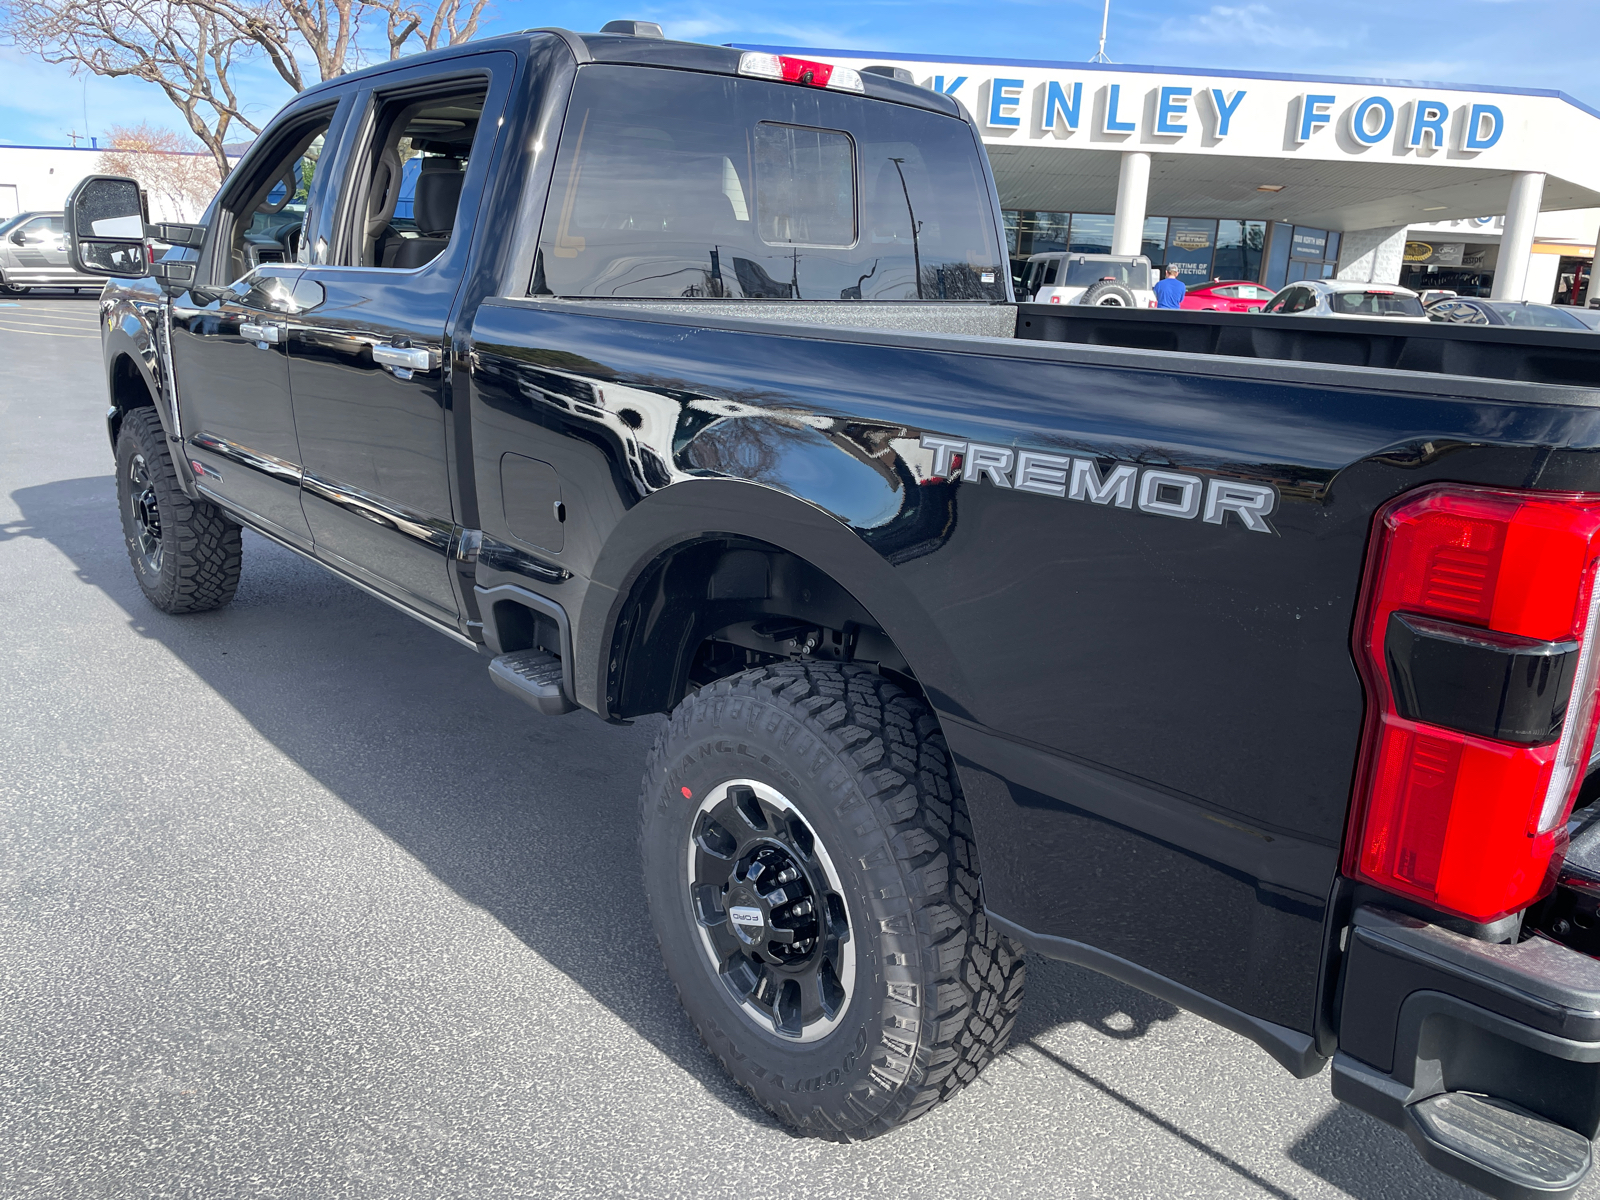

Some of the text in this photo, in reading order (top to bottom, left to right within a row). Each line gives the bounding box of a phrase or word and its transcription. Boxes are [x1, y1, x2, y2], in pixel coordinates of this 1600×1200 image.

[1300, 94, 1504, 149] FORD
[919, 432, 1279, 535] TREMOR
[656, 739, 802, 812] WRANGLER
[732, 913, 759, 922] FORD
[705, 1017, 868, 1094] GOODYEAR
